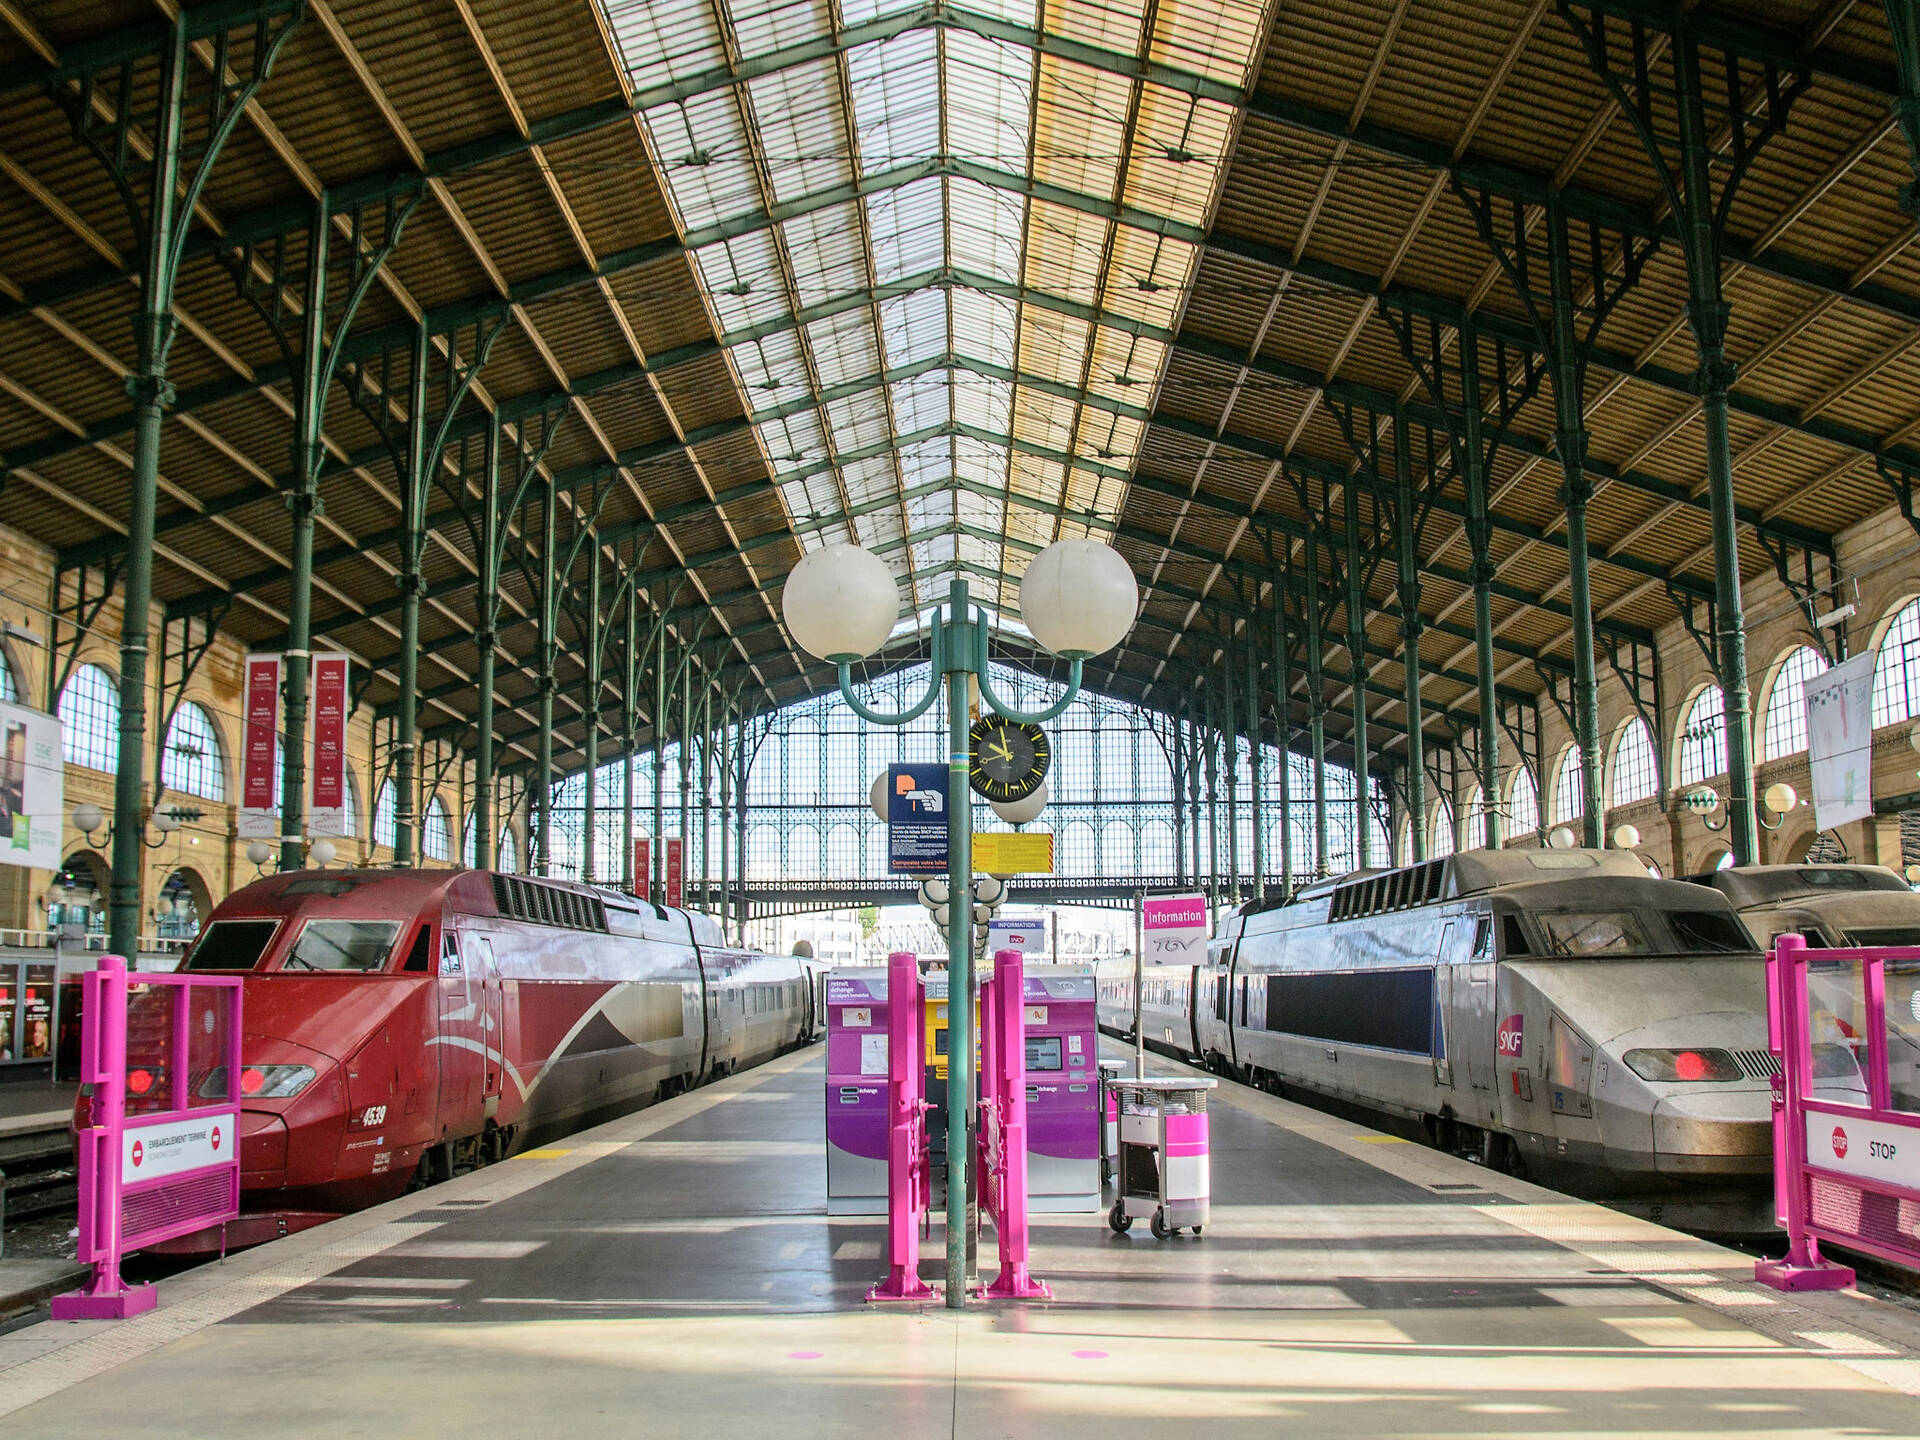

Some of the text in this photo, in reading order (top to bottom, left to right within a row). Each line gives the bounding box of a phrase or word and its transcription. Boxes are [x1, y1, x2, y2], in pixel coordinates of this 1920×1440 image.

[1149, 909, 1202, 923] information
[1500, 1030, 1522, 1052] SNCF
[148, 1134, 187, 1149] EMBARQUEMENT
[1833, 1135, 1897, 1160] STOP STOP
